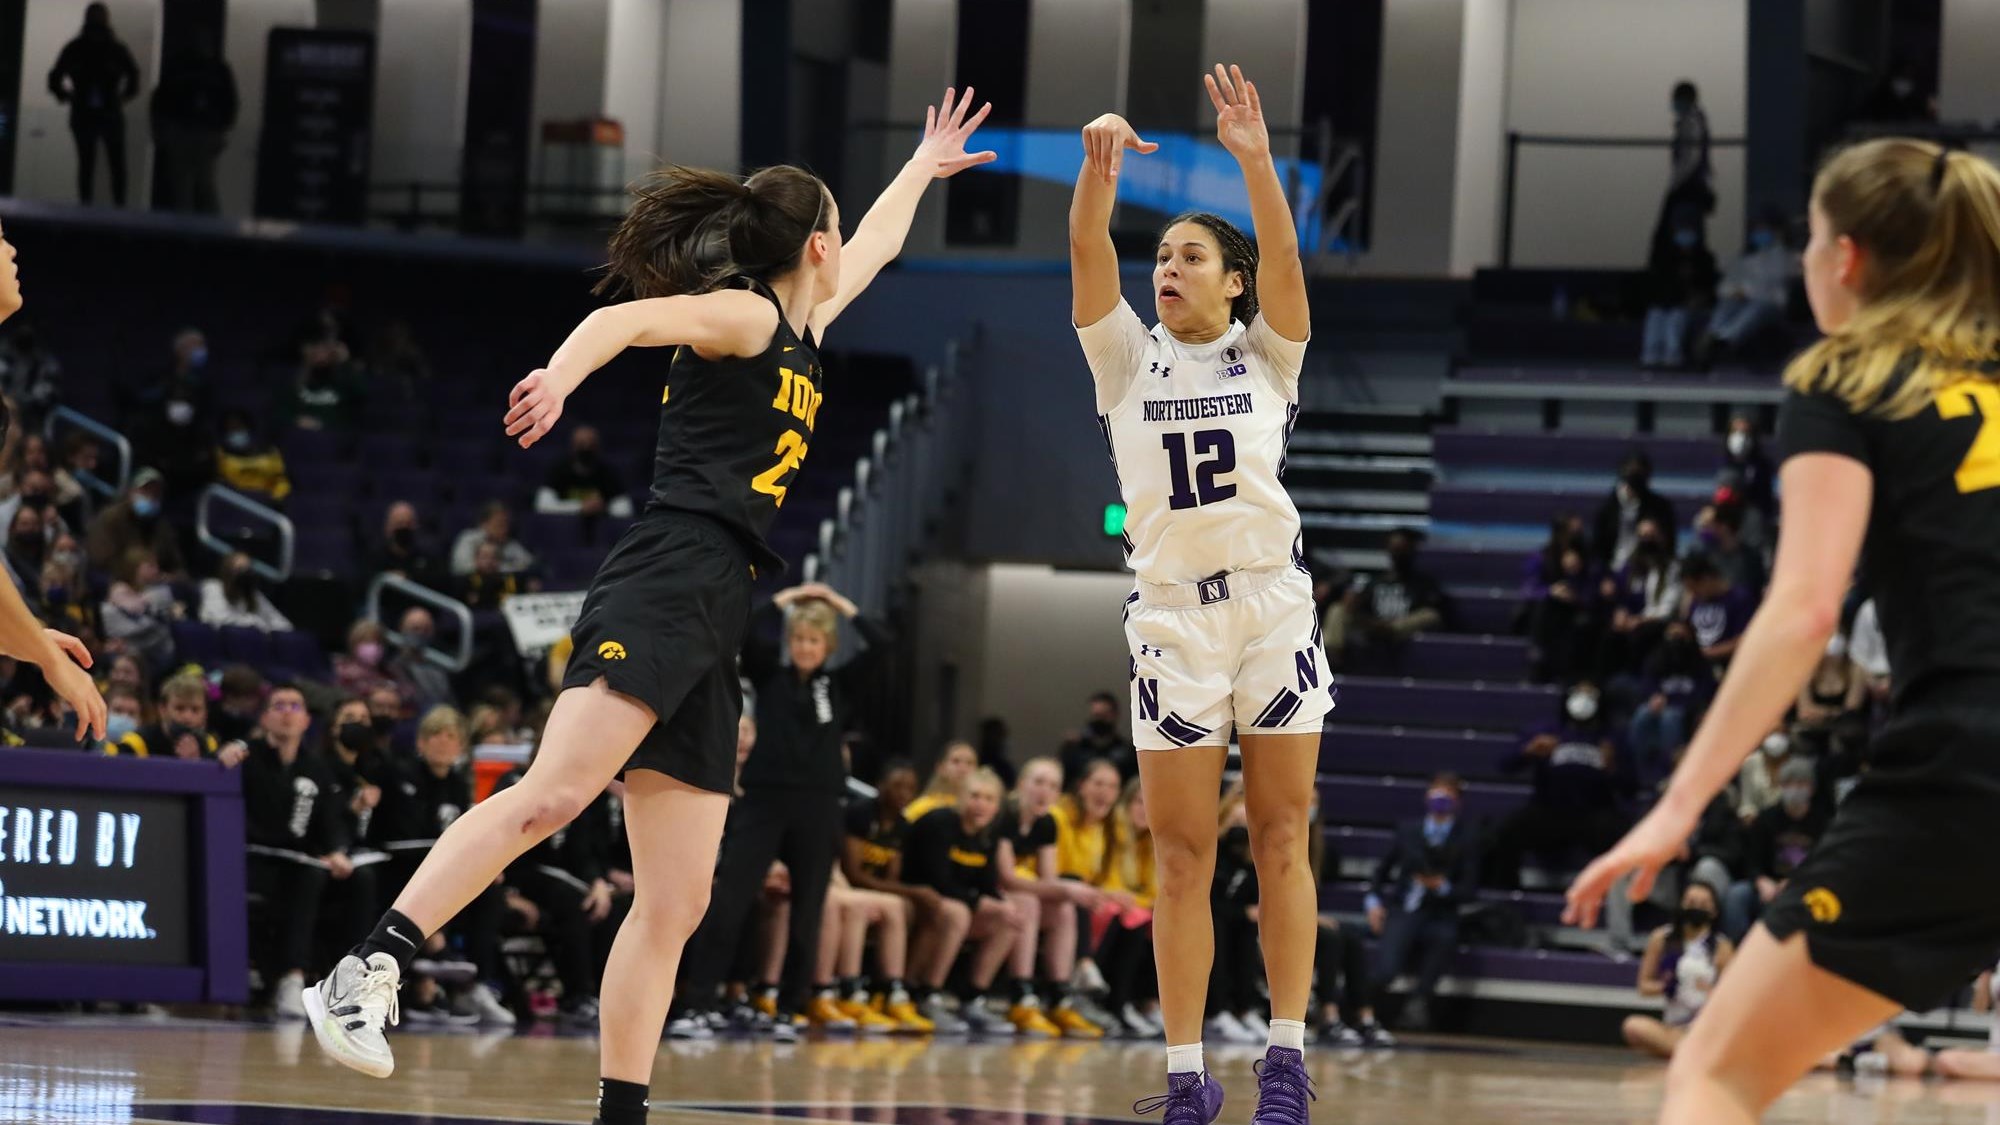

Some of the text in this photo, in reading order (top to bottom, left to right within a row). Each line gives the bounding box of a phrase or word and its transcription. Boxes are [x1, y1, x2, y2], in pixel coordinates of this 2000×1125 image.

[1143, 393, 1253, 422] NORTHWESTERN
[1162, 428, 1237, 510] 12
[1295, 647, 1319, 693] N
[1138, 678, 1159, 721] N
[96, 811, 141, 868] BY
